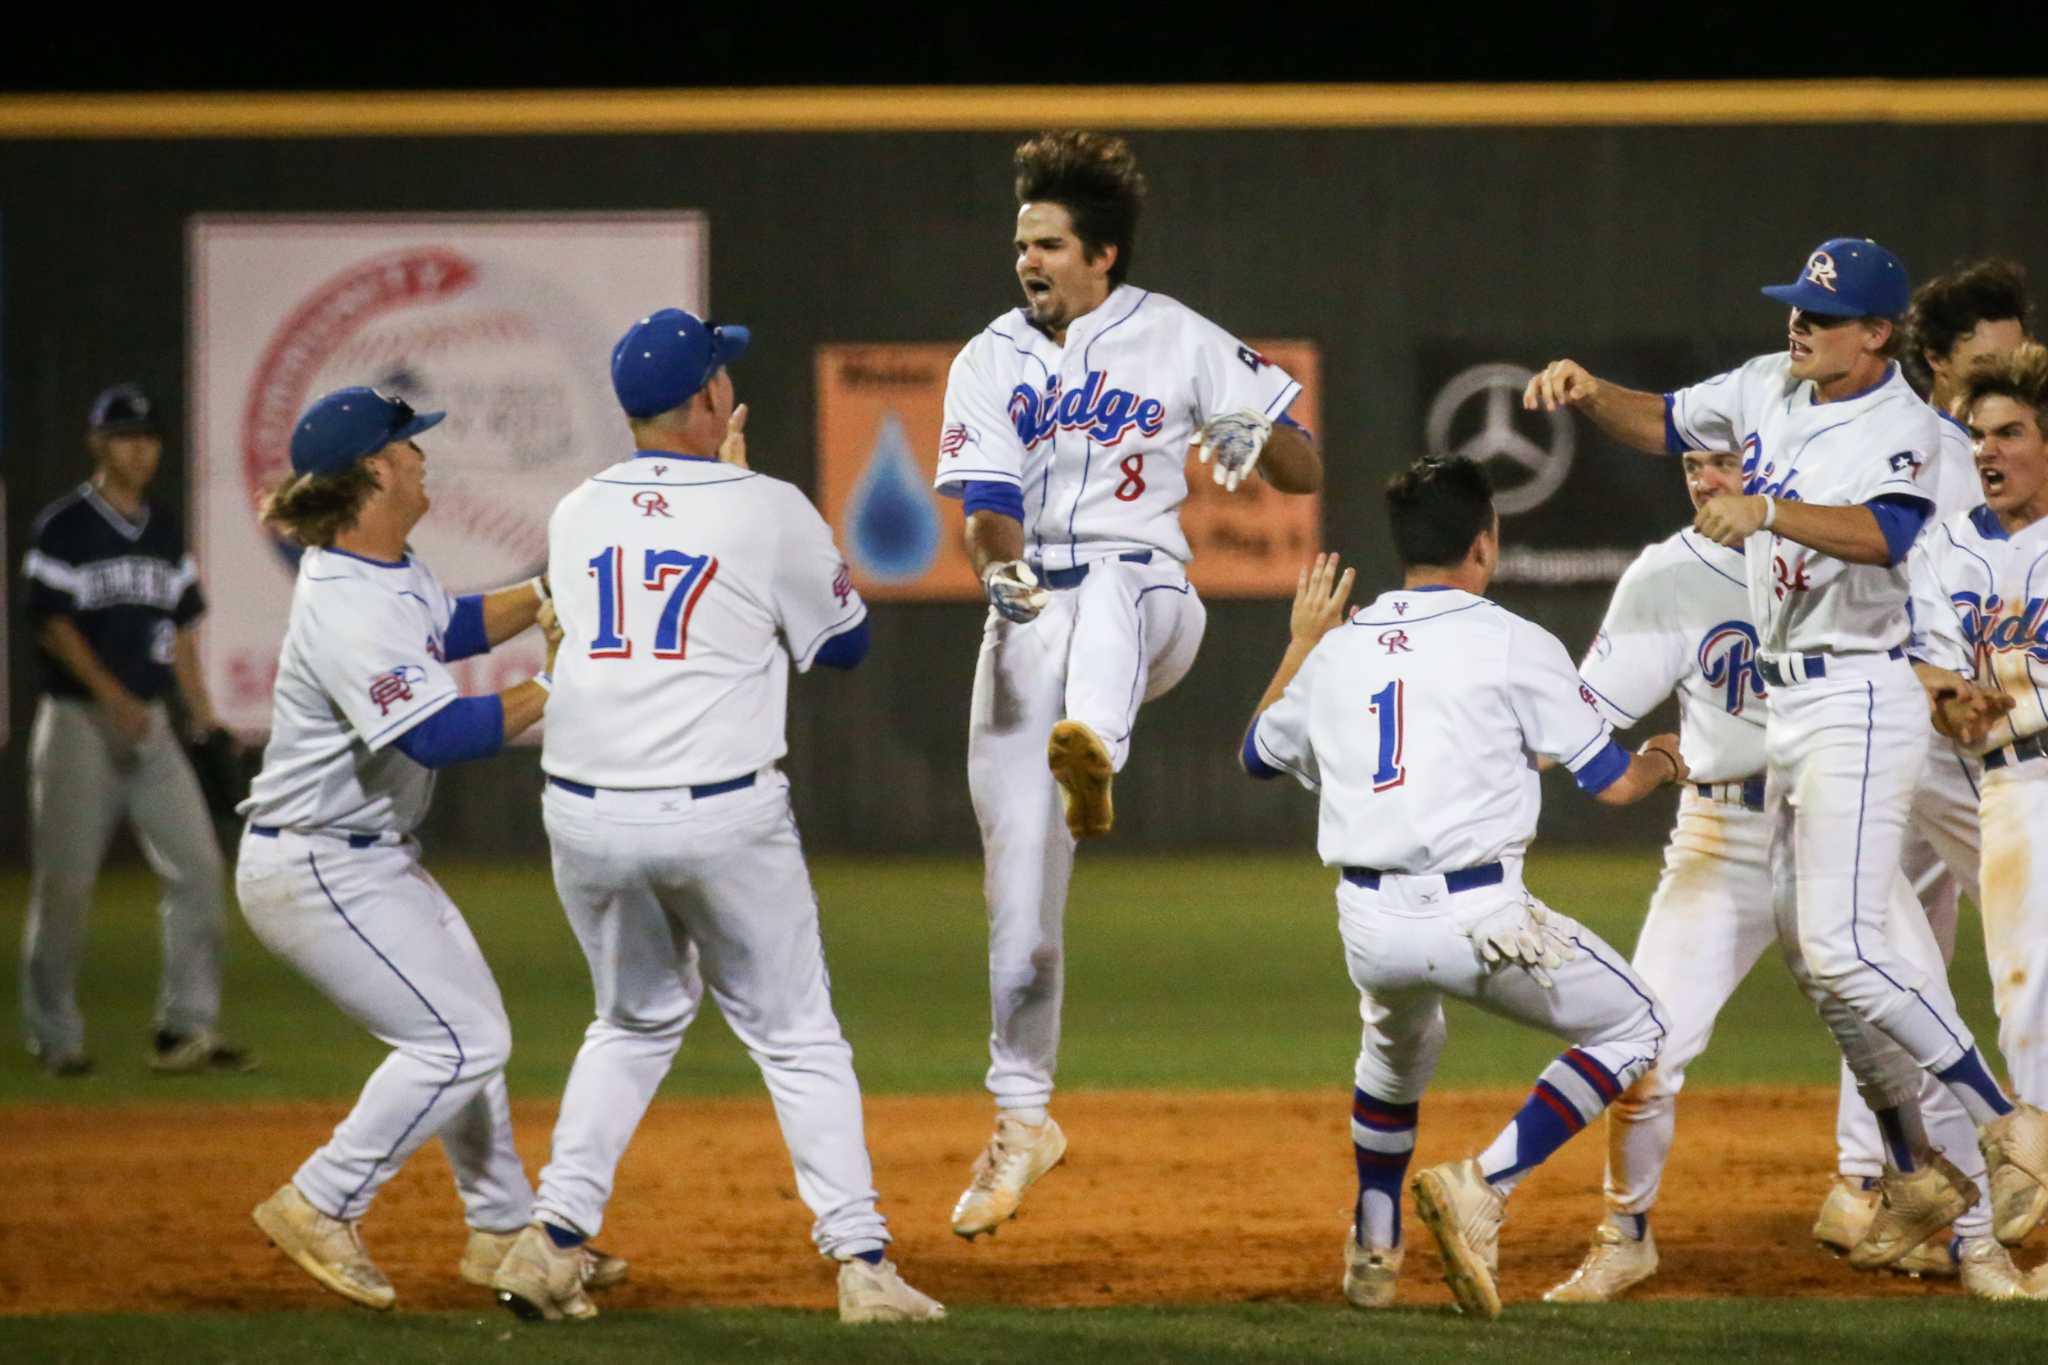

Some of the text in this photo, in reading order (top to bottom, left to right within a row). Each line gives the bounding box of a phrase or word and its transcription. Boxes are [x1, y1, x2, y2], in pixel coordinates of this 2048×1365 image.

[1114, 452, 1146, 502] 8
[588, 545, 718, 660] 17
[1369, 678, 1405, 793] 1
